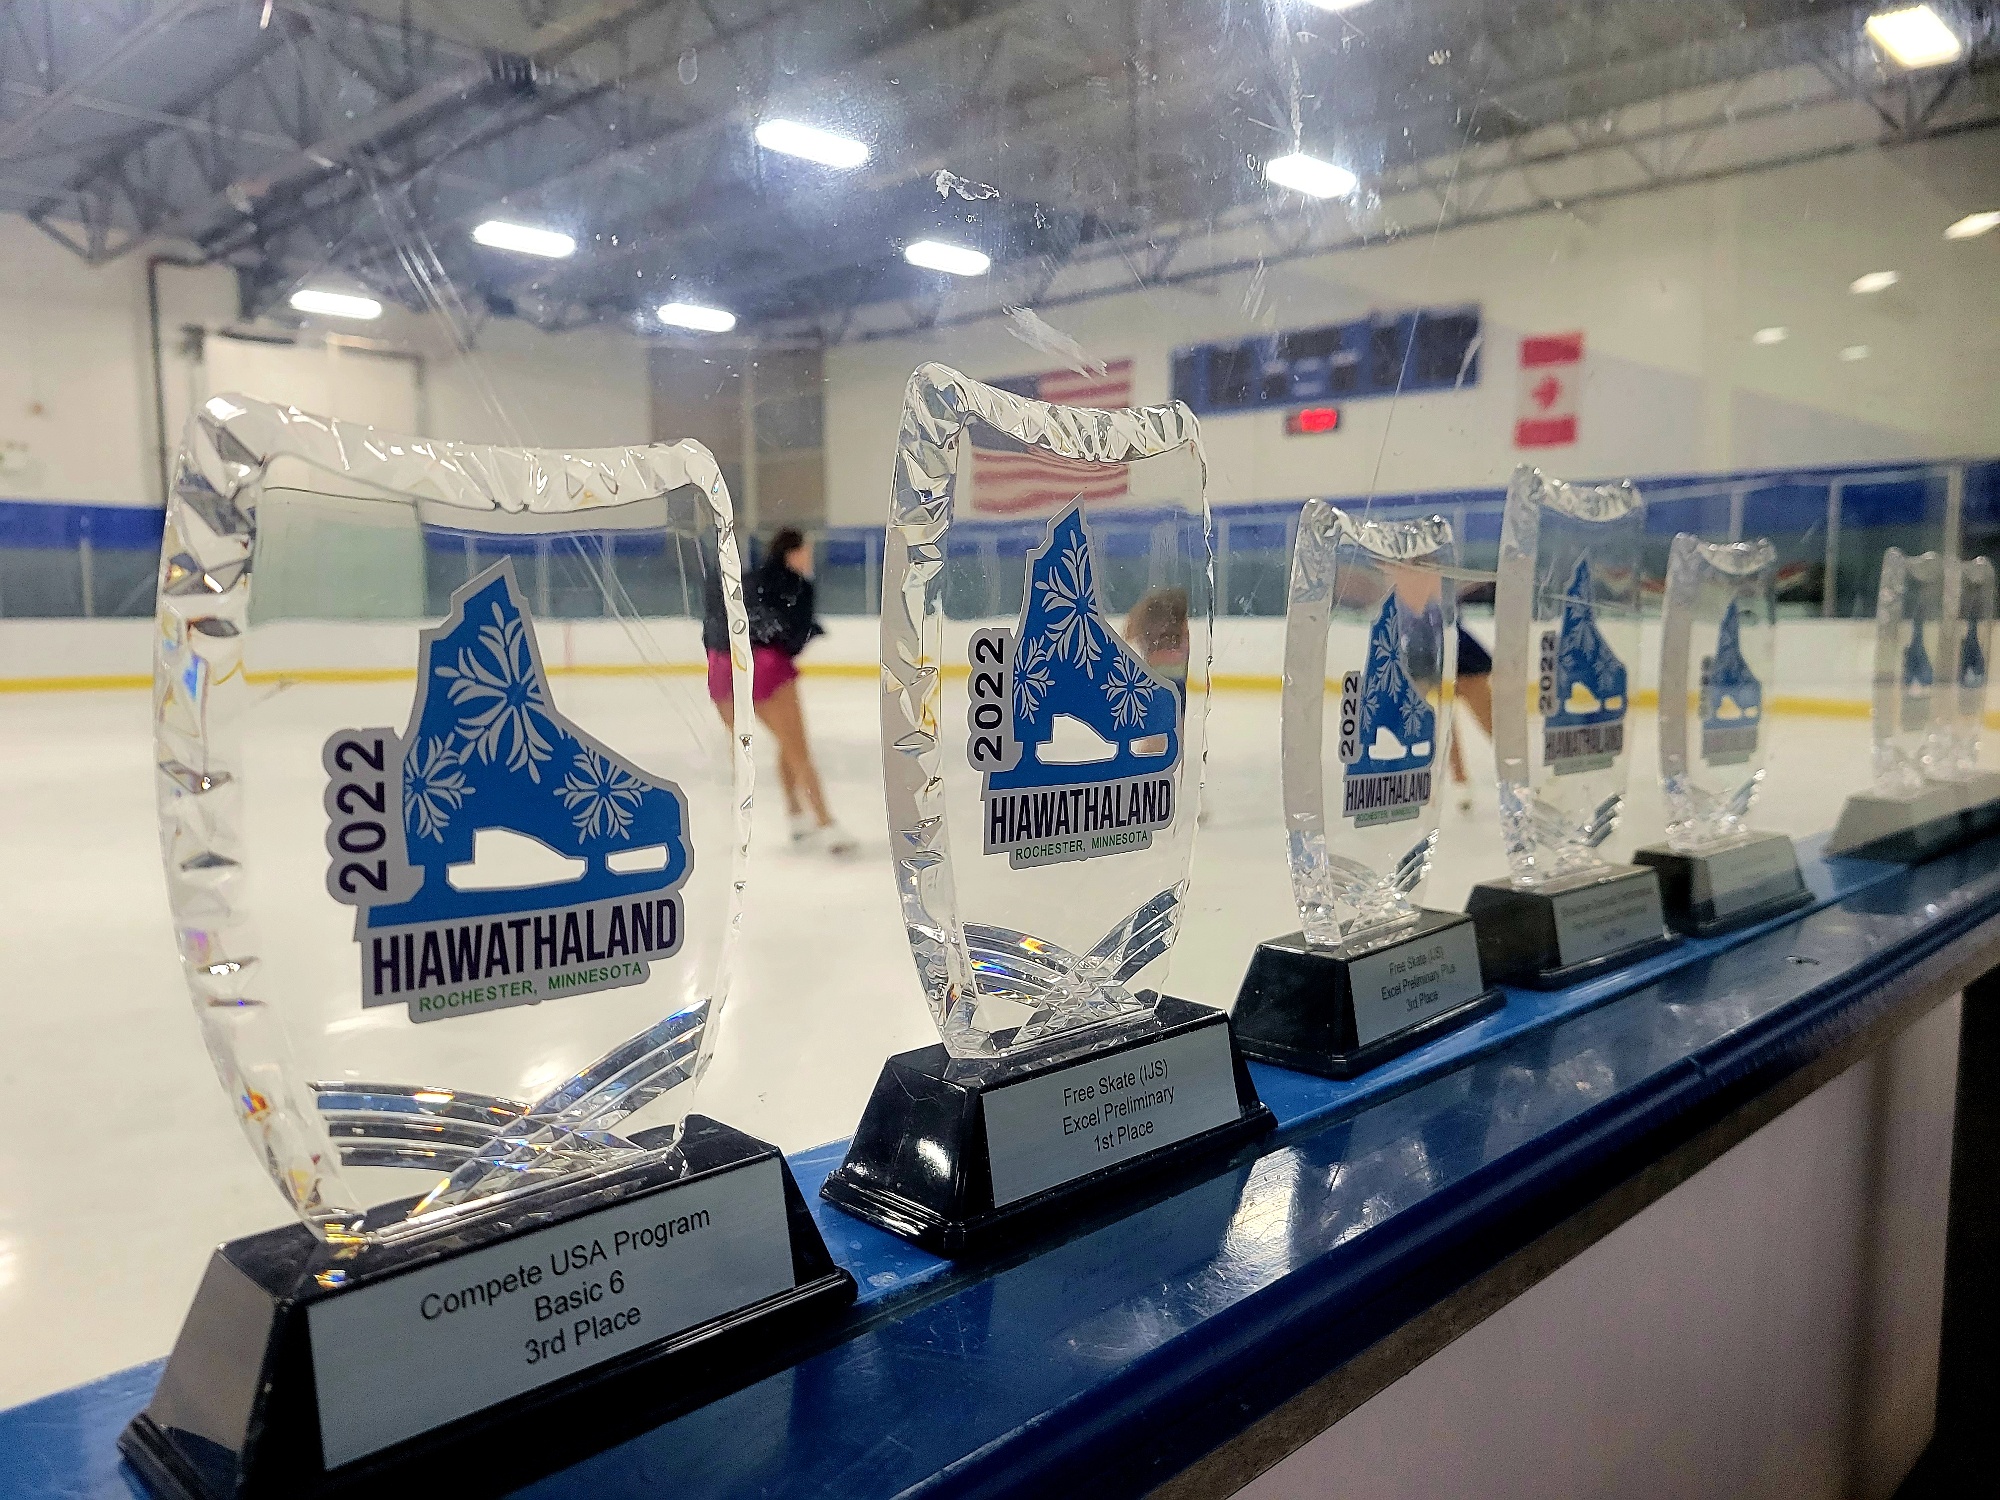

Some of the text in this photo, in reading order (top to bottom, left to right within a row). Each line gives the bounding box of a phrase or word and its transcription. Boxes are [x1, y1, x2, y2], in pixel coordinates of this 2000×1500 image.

[974, 637, 1004, 762] 2022
[1341, 676, 1358, 757] 2022
[335, 738, 388, 893] 2022
[990, 779, 1171, 845] HIAWATHALAND
[1345, 772, 1431, 811] HIAWATHALAND
[1015, 830, 1148, 860] ROCHESTER, MINNESOTA
[373, 898, 677, 995] HIAWATHALAND
[419, 962, 643, 1012] ROCHESTER, MINNESOTA
[1381, 983, 1401, 1000] Excel
[1063, 1058, 1168, 1106] Free Skate (IJS)
[1062, 1086, 1175, 1136] Excel Preliminary
[1094, 1121, 1154, 1152] 1st Place
[420, 1208, 711, 1320] Compete USA Program
[534, 1269, 625, 1321] Basic 6
[524, 1306, 641, 1365] 3rd Place
